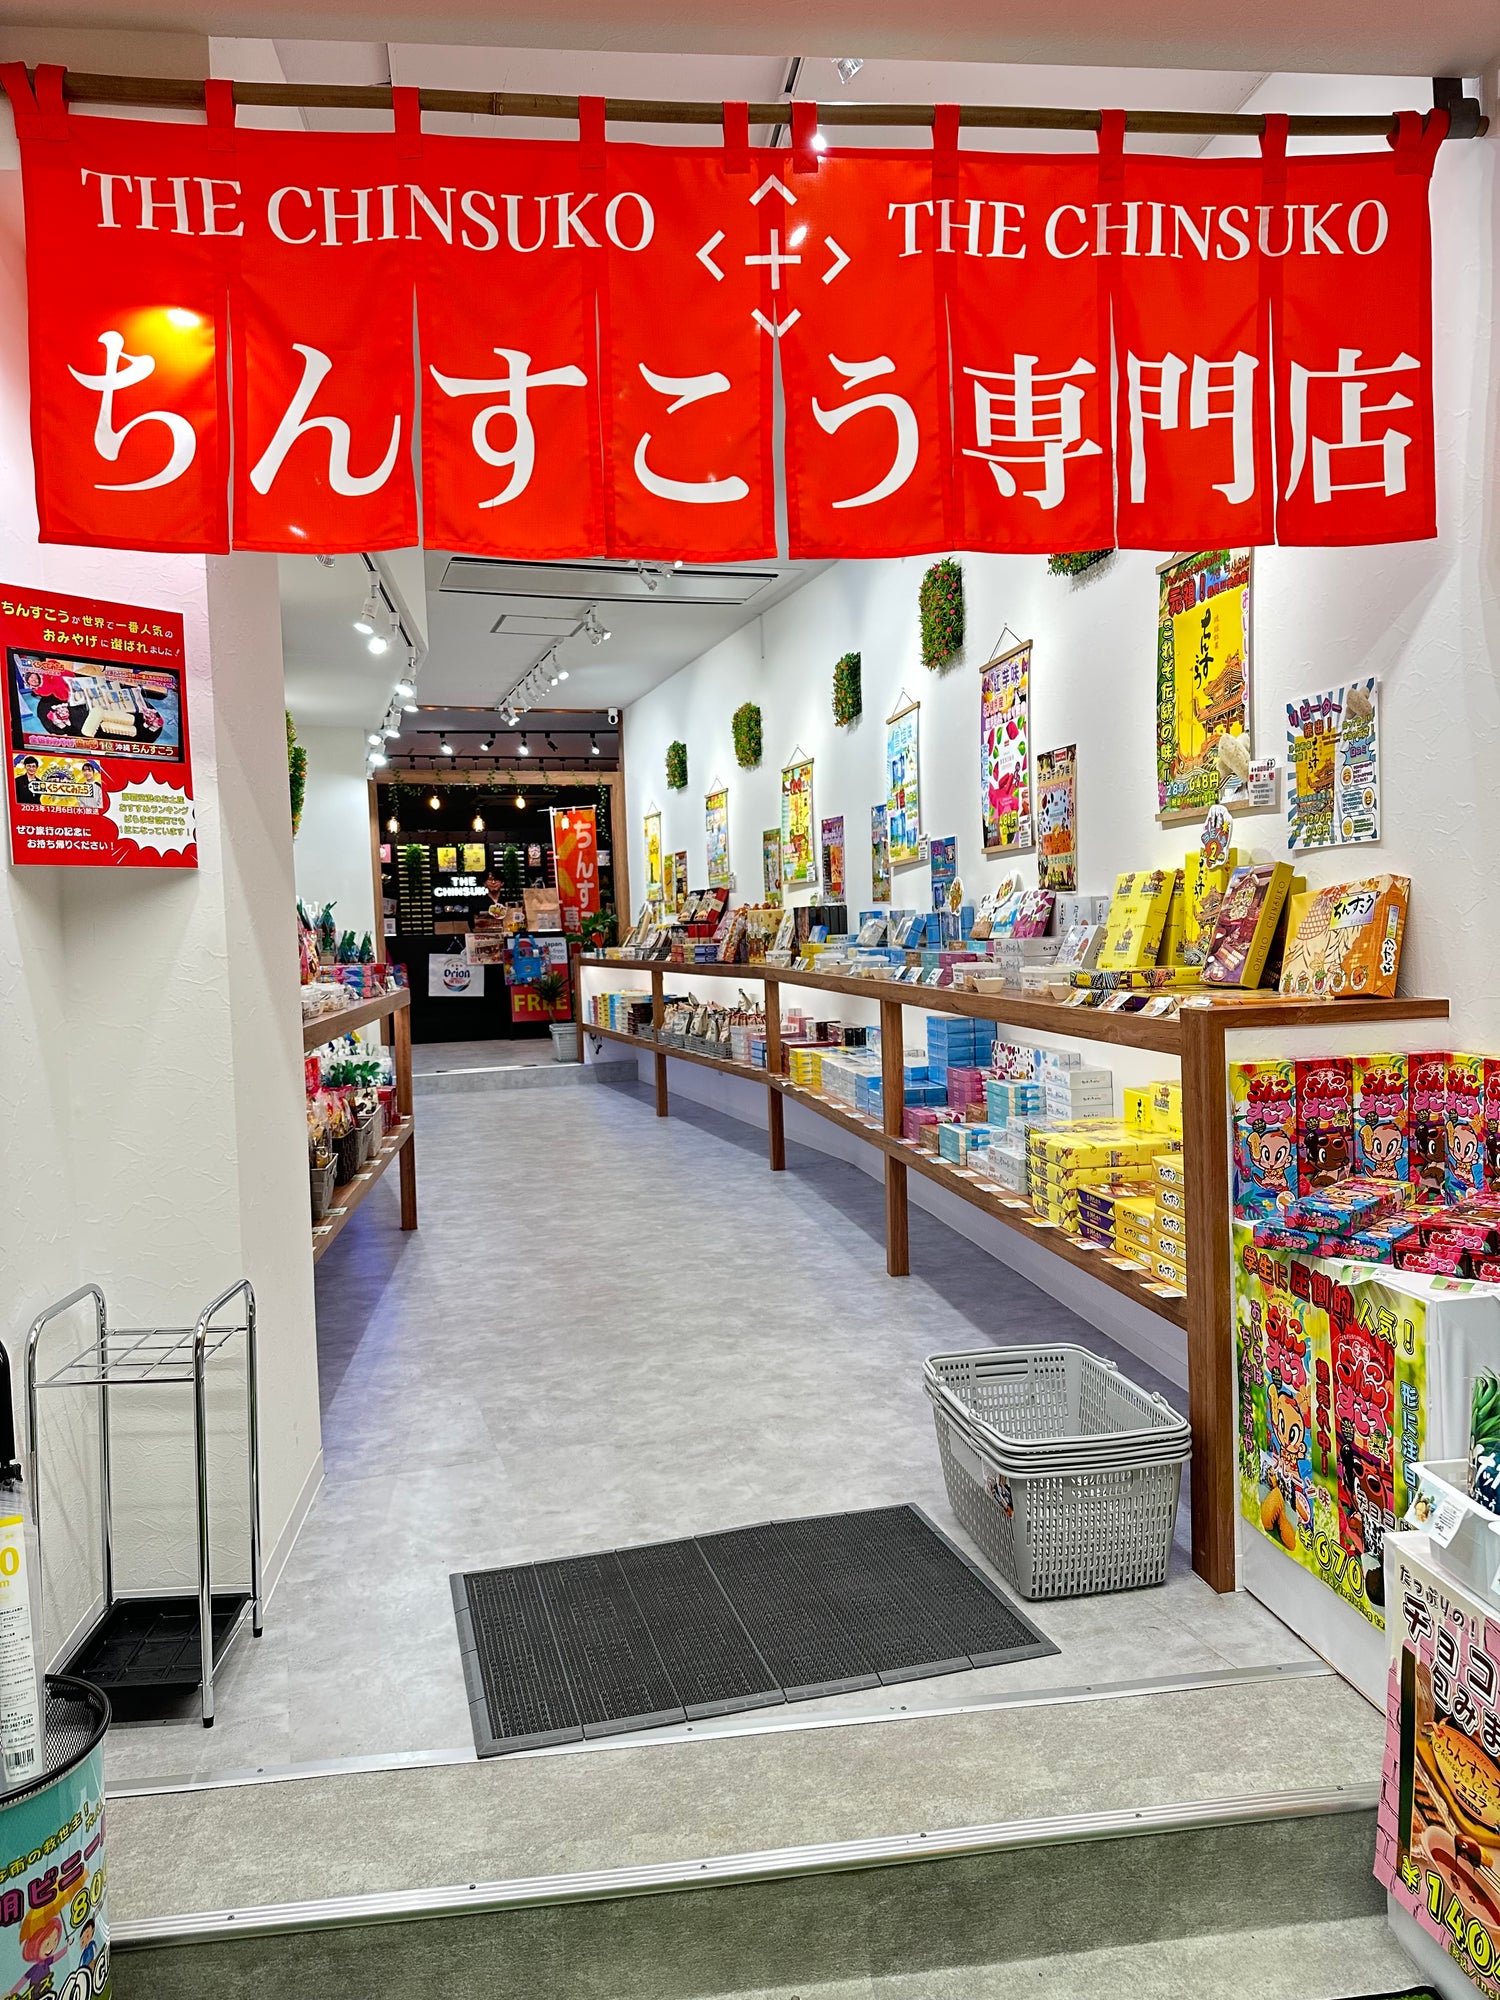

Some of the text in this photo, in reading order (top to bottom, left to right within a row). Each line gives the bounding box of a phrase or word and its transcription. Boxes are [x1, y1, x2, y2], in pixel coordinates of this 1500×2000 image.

[81, 168, 656, 254] THE CHINSUKO
[888, 199, 1390, 262] THE CHINSUKO
[66, 330, 1422, 511] ちんすこう専門店
[450, 876, 477, 887] THE
[443, 967, 471, 979] Orion
[1402, 1591, 1500, 1708] チョコ
[1401, 1855, 1500, 1984] ¥140
